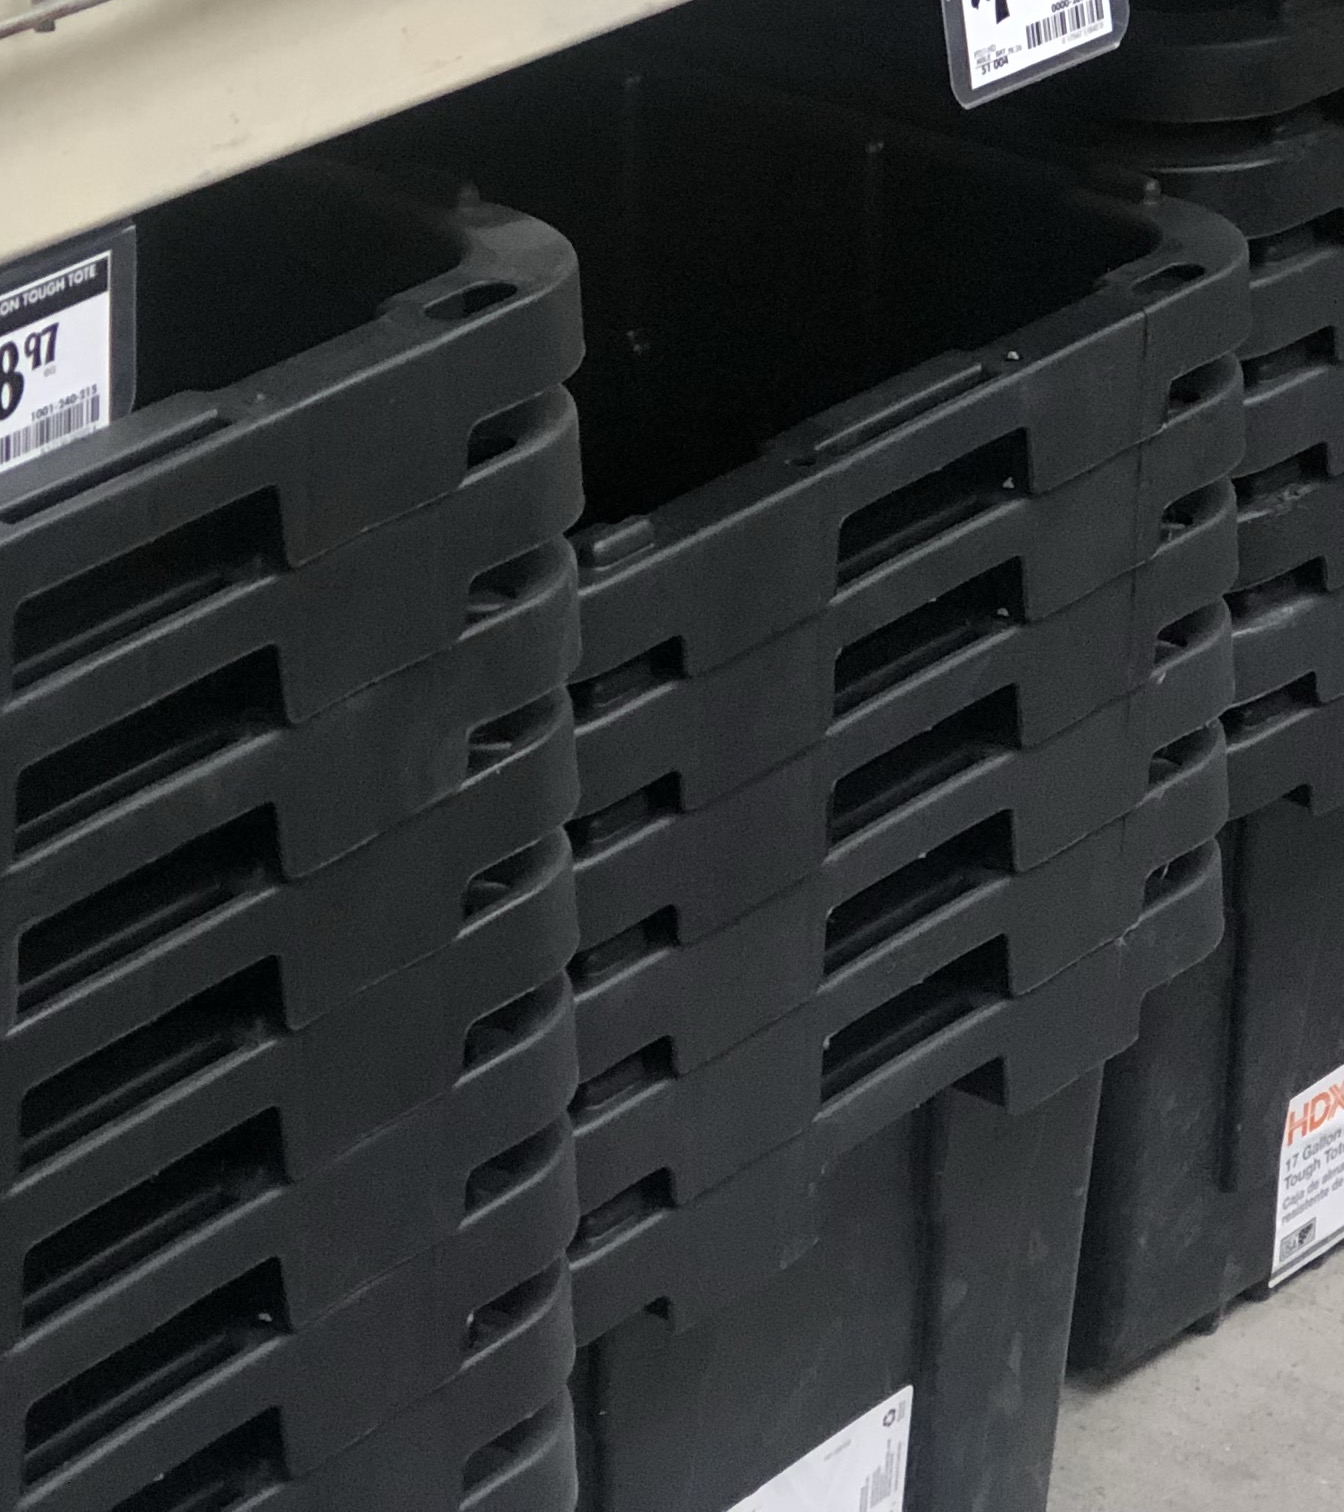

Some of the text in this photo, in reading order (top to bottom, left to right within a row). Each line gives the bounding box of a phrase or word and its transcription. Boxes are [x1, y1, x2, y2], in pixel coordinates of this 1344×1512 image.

[21, 278, 66, 305] TOUGH
[67, 263, 97, 288] TOTE
[1285, 1128, 1342, 1173] 17 Gallon
[1284, 1157, 1322, 1190] Tough
